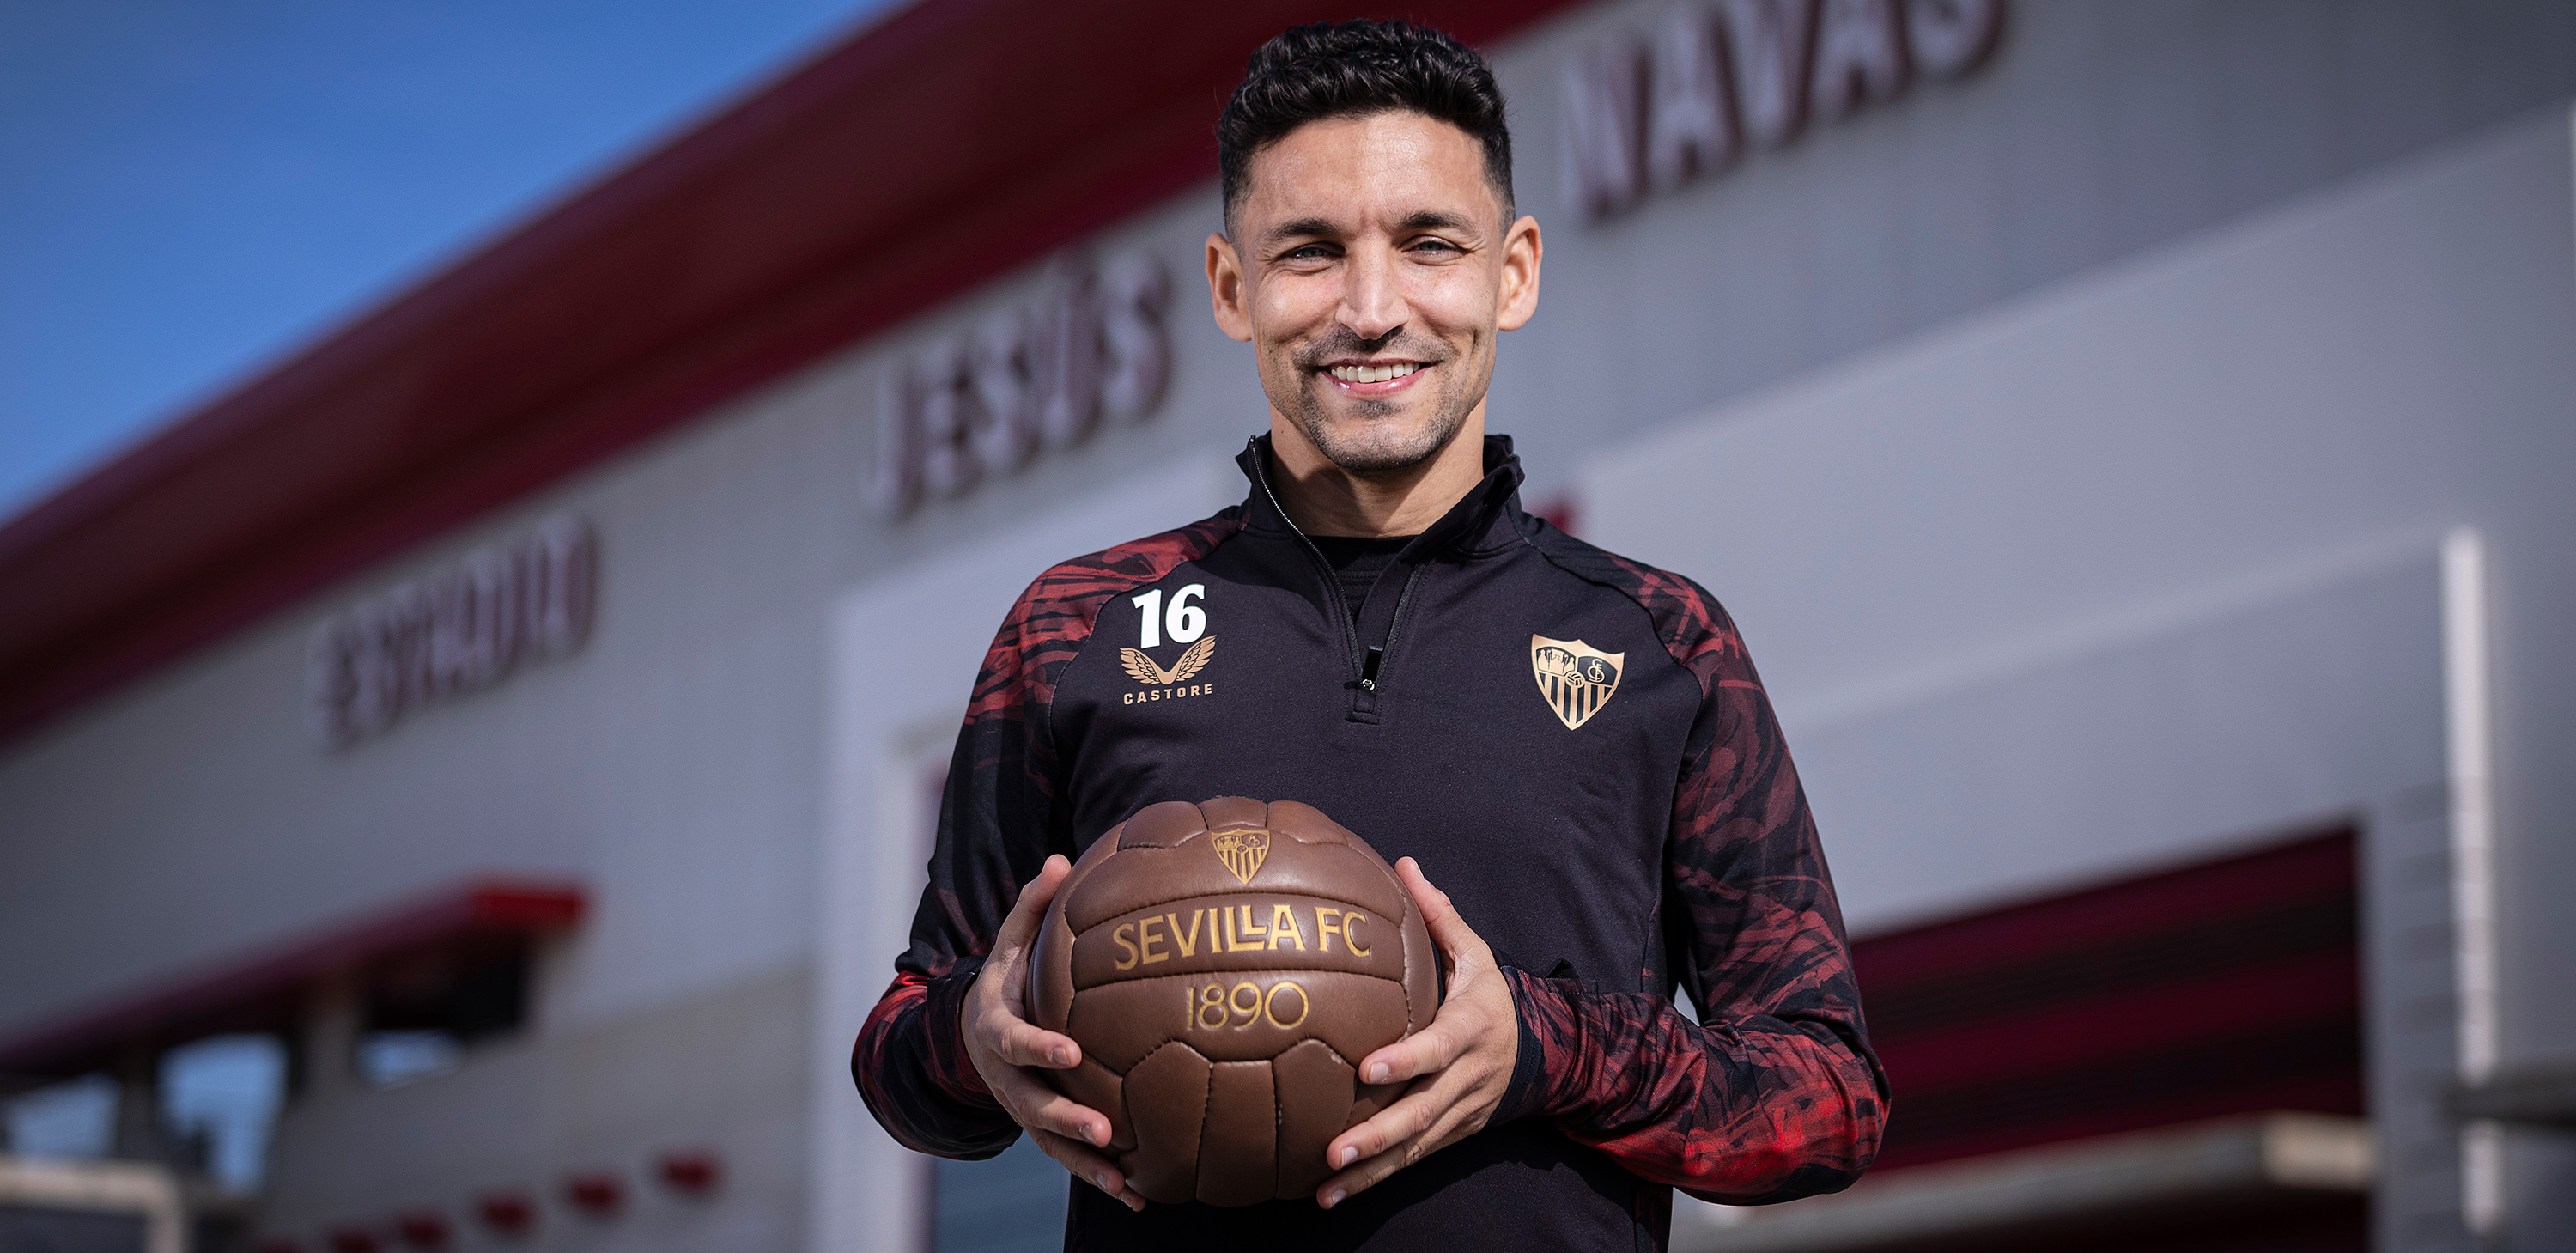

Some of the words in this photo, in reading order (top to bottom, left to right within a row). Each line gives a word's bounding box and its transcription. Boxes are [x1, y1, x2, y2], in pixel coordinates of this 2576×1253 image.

[1131, 582, 1207, 649] 16
[1123, 683, 1213, 705] CASTORE
[1113, 904, 1306, 970] SEVILLA
[1314, 906, 1372, 958] FC
[1187, 982, 1310, 1031] 1890
